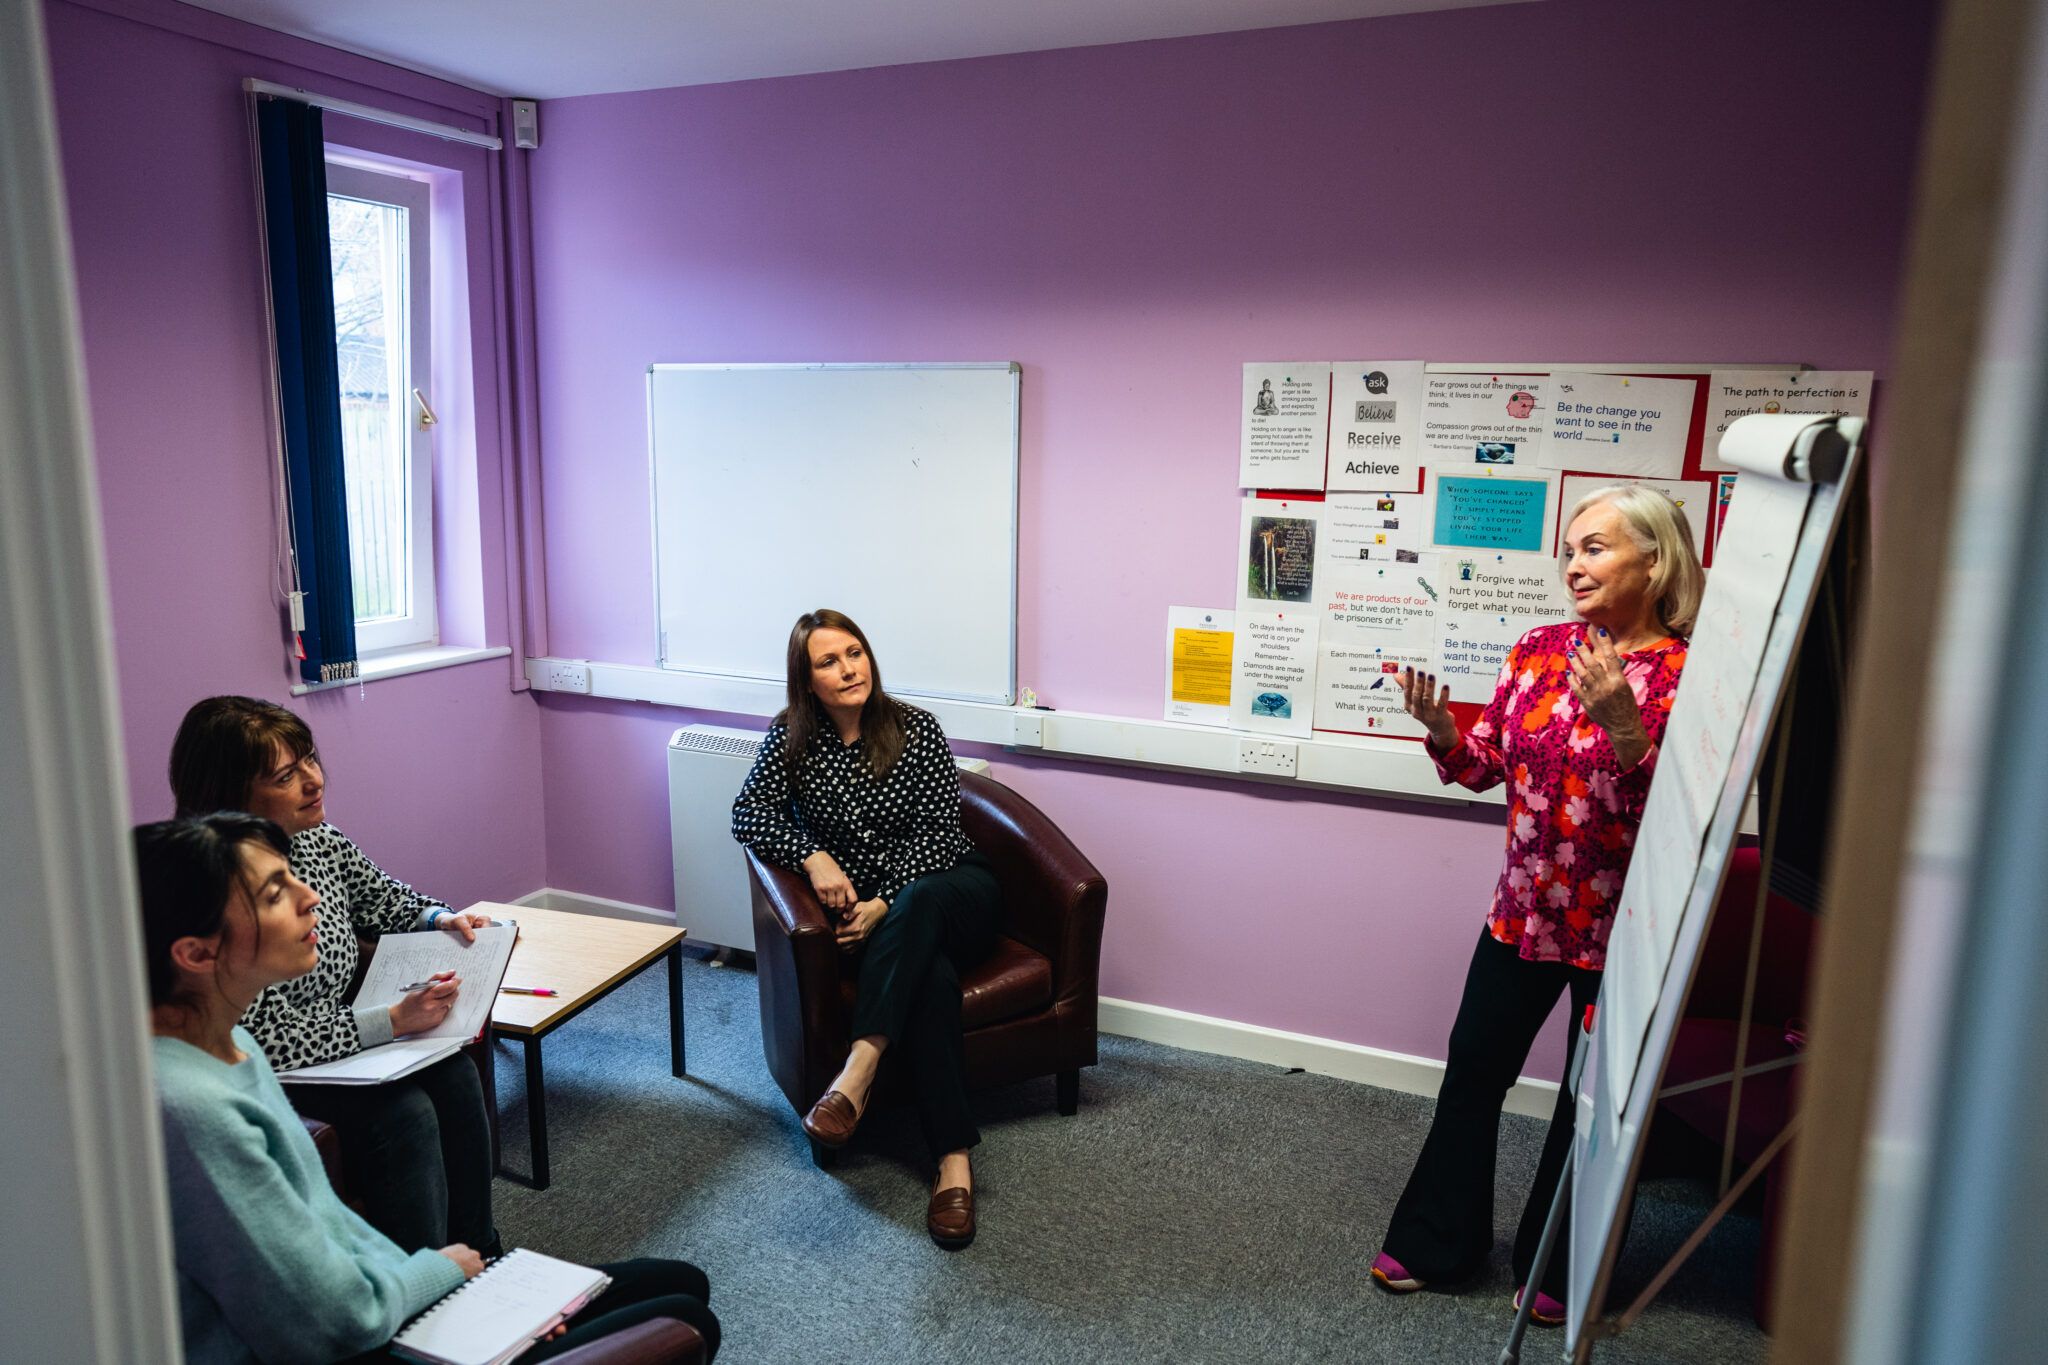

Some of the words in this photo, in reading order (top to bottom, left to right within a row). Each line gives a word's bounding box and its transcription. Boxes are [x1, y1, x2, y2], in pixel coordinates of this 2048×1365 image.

[1368, 377, 1386, 387] ask
[1505, 383, 1526, 391] things
[1723, 387, 1742, 396] The
[1746, 388, 1769, 398] path
[1773, 388, 1784, 396] to
[1787, 388, 1845, 399] perfection
[1848, 389, 1858, 398] is
[1358, 405, 1394, 420] Believe
[1557, 402, 1572, 411] Be
[1576, 404, 1593, 413] the
[1596, 405, 1637, 418] change
[1640, 409, 1661, 419] you
[1556, 418, 1581, 426] want
[1584, 419, 1595, 427] to
[1598, 421, 1618, 429] see
[1621, 420, 1630, 430] in
[1635, 422, 1652, 432] the
[1348, 432, 1401, 445] Receive
[1554, 431, 1583, 440] world
[1345, 461, 1399, 474] Achieve
[1476, 574, 1514, 585] Forgive
[1518, 577, 1544, 586] what
[1336, 591, 1348, 599] We
[1366, 594, 1401, 604] products
[1449, 586, 1470, 595] hurt
[1474, 589, 1493, 597] you
[1496, 589, 1514, 598] but
[1518, 592, 1548, 600] never
[1328, 602, 1347, 611] past,
[1351, 604, 1364, 612] but
[1380, 606, 1401, 615] don't
[1403, 608, 1422, 616] have
[1425, 609, 1434, 617] to
[1448, 600, 1478, 611] forget
[1482, 603, 1508, 612] what
[1512, 606, 1530, 615] you
[1535, 607, 1566, 616] learnt
[1347, 614, 1382, 623] prisoners
[1385, 617, 1393, 625] of
[1260, 624, 1274, 632] days
[1260, 643, 1290, 651] shoulders
[1445, 639, 1458, 648] Be
[1462, 640, 1478, 649] the
[1255, 653, 1288, 661] Remember
[1349, 652, 1375, 660] moment
[1376, 652, 1382, 660] is
[1444, 653, 1468, 662] want
[1471, 654, 1480, 662] to
[1484, 656, 1502, 664] see
[1243, 662, 1274, 670] Diamonds
[1359, 666, 1380, 674] painful
[1443, 665, 1470, 674] world
[1257, 681, 1288, 690] mountains
[1341, 683, 1368, 691] beautiful
[1335, 702, 1356, 710] What
[1366, 705, 1384, 713] your
